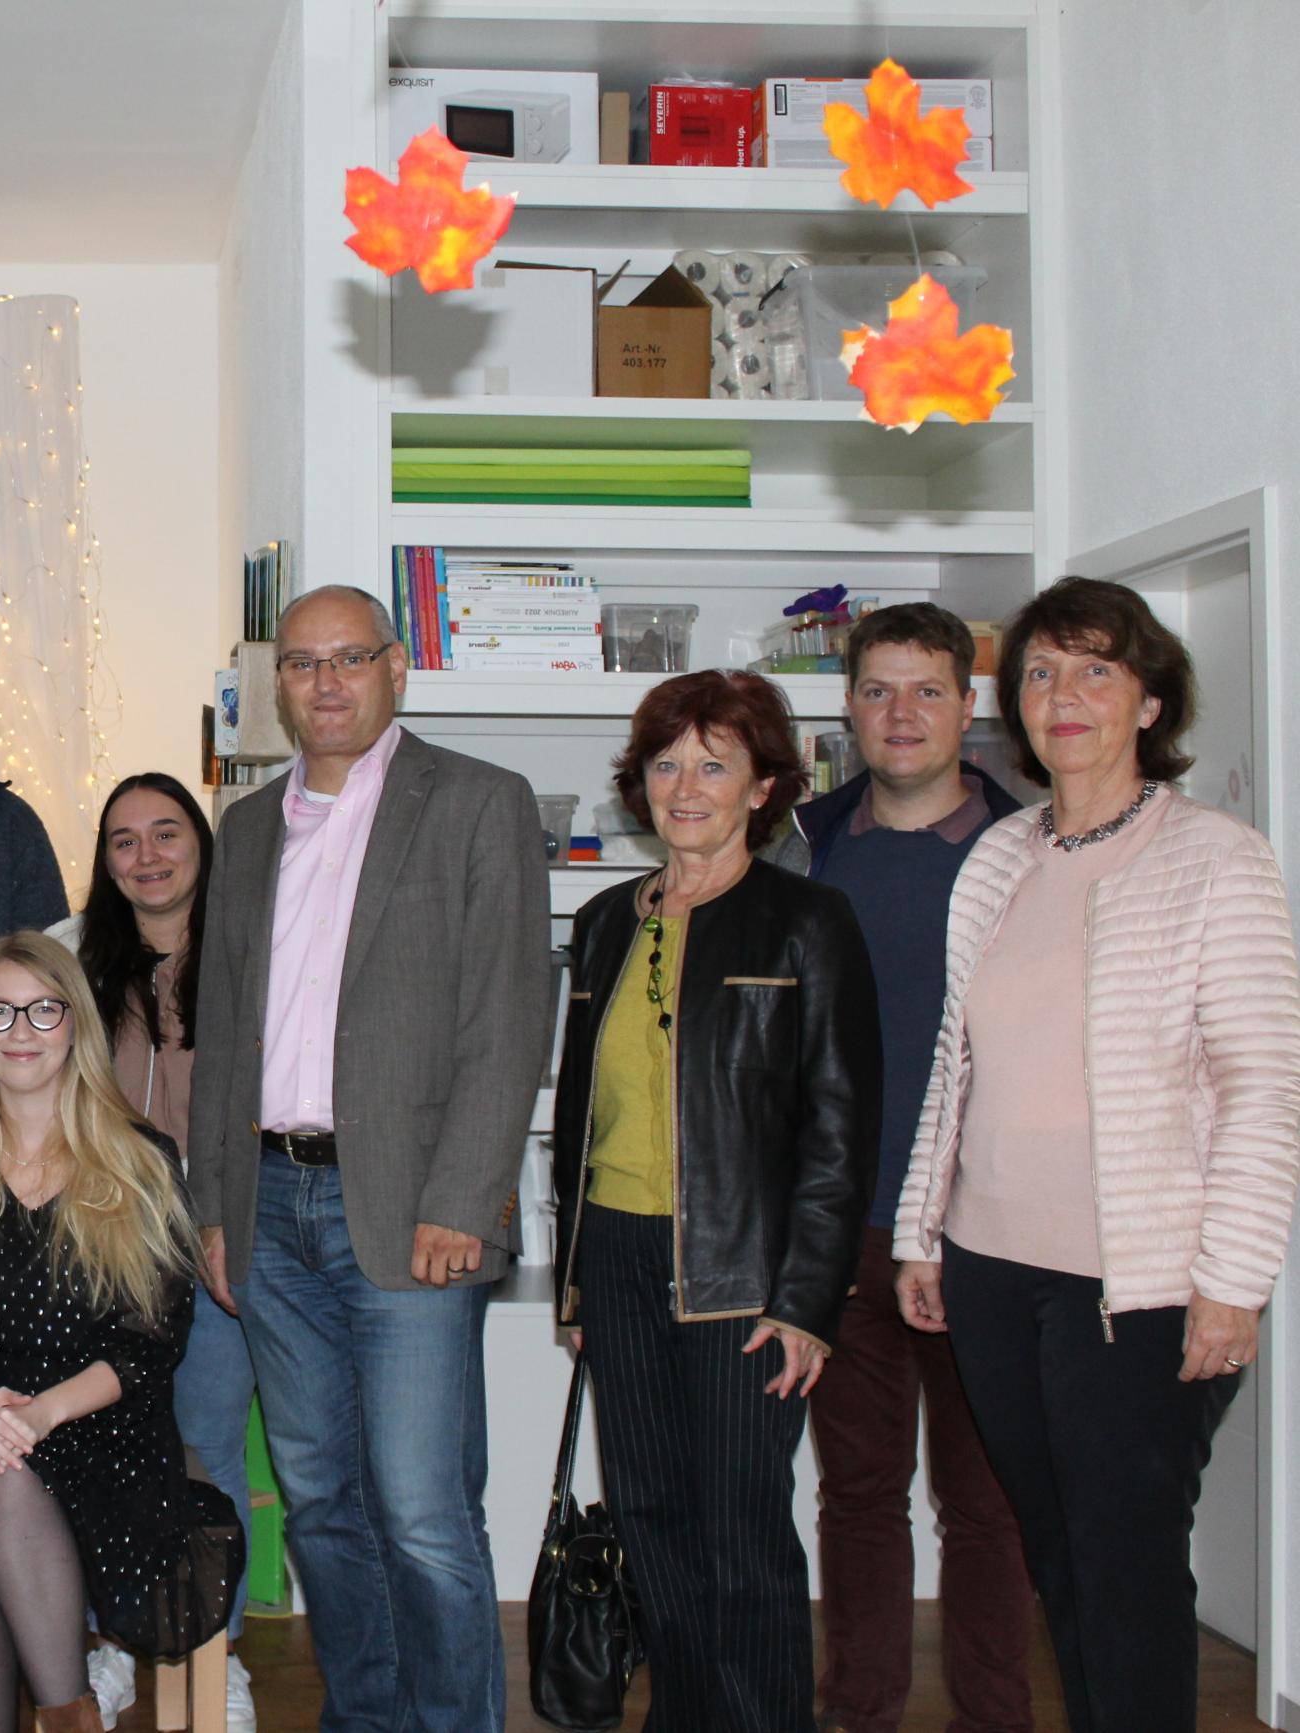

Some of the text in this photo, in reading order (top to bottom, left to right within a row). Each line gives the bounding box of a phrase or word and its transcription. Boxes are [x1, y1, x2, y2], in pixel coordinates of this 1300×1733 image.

[656, 91, 664, 135] SEVERIN
[737, 125, 746, 139] up.
[622, 357, 667, 369] 403.177
[551, 660, 578, 671] HABA
[578, 661, 593, 671] Pro
